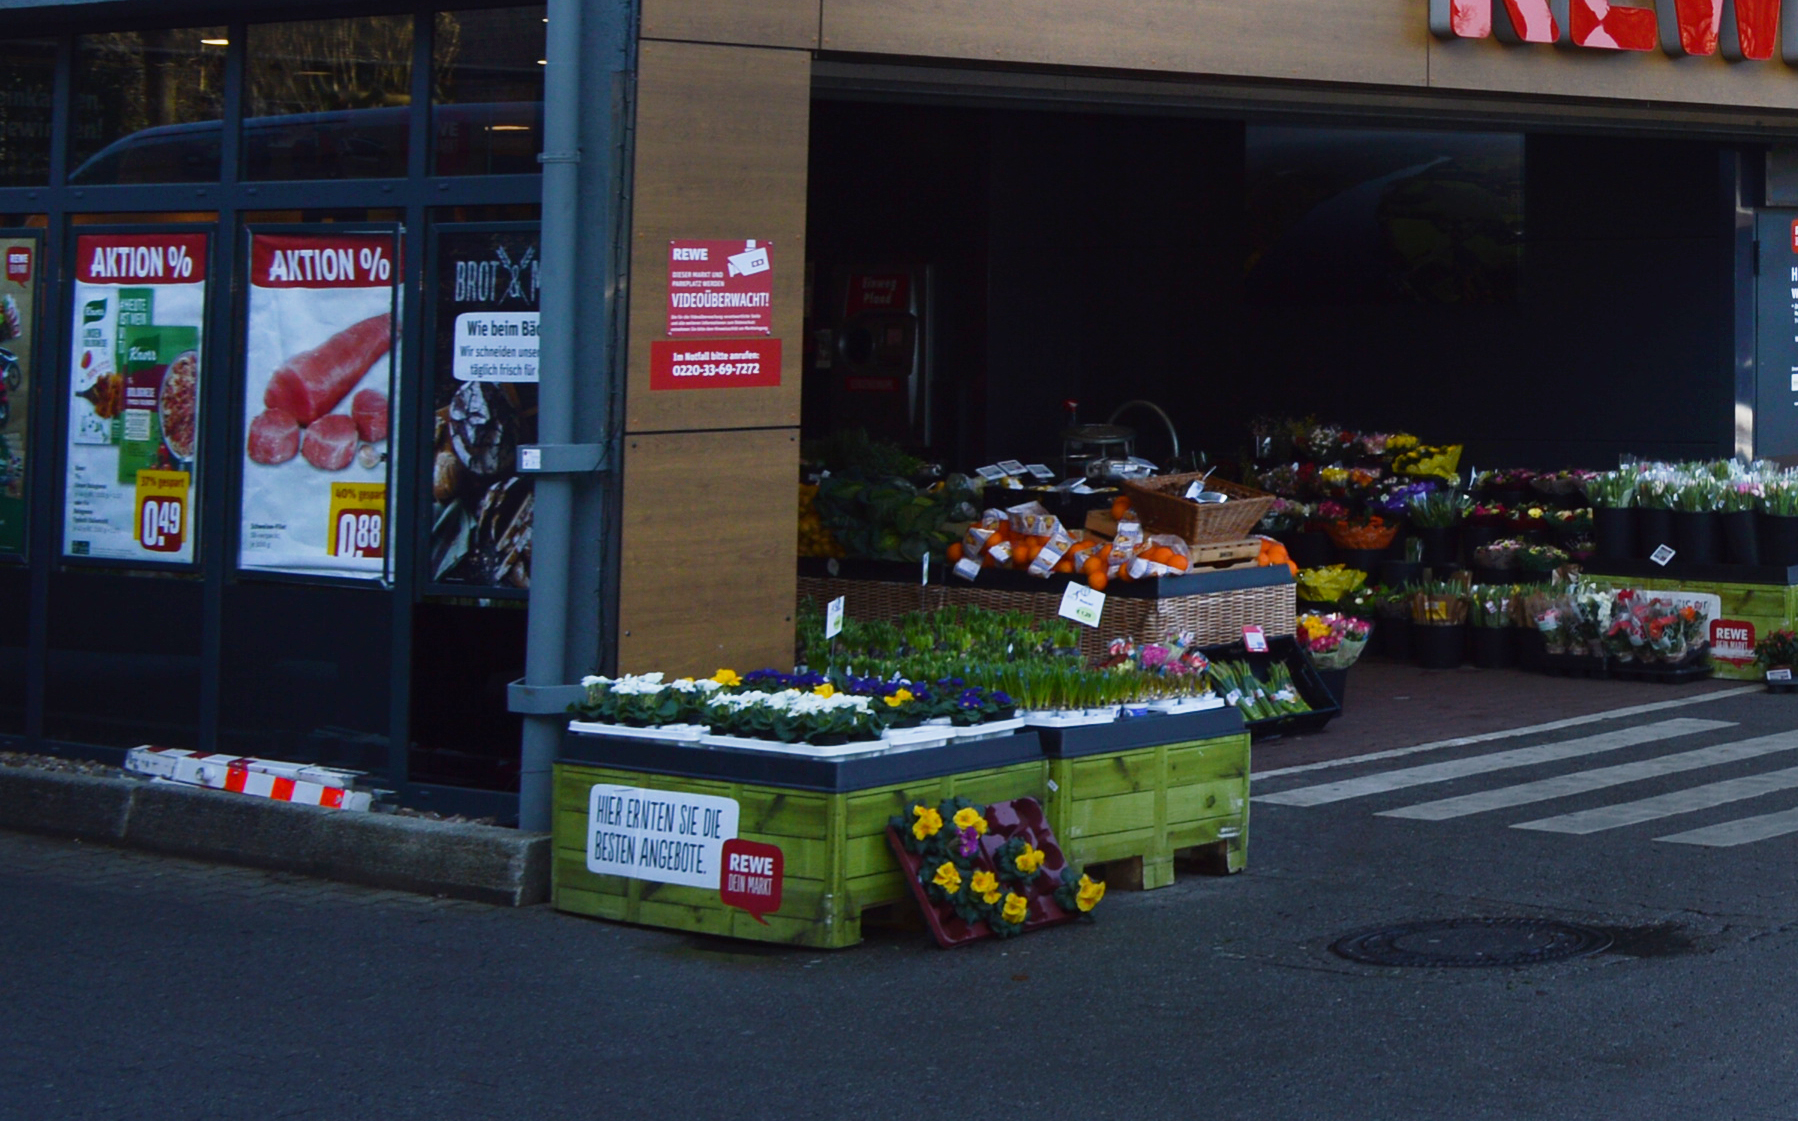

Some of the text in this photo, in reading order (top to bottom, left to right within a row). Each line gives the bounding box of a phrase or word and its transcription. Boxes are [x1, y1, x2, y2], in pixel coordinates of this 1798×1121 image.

[91, 245, 192, 278] AKTION %
[673, 248, 708, 261] REWE
[269, 247, 390, 281] AKTION %
[455, 260, 500, 301] BROT
[671, 289, 770, 308] VIDEOÜBERWACHT!
[467, 321, 488, 336] Wie
[491, 321, 519, 336] beim
[460, 346, 474, 357] Wir
[475, 346, 517, 357] schneiden
[673, 350, 760, 361] Im Notfall bitte anrufen:
[470, 364, 536, 378] täglich frisch für
[672, 363, 760, 376] 0220-33-69-7272
[141, 476, 184, 489] 37% gespart
[336, 488, 356, 499] 40%
[1716, 627, 1749, 640] REWE
[596, 795, 722, 839] HIER ERNTEN SIE DIE
[594, 831, 707, 875] BESTEN ANGEBOTE.
[729, 853, 774, 876] REWE
[728, 873, 773, 896] DEIN MARKT
